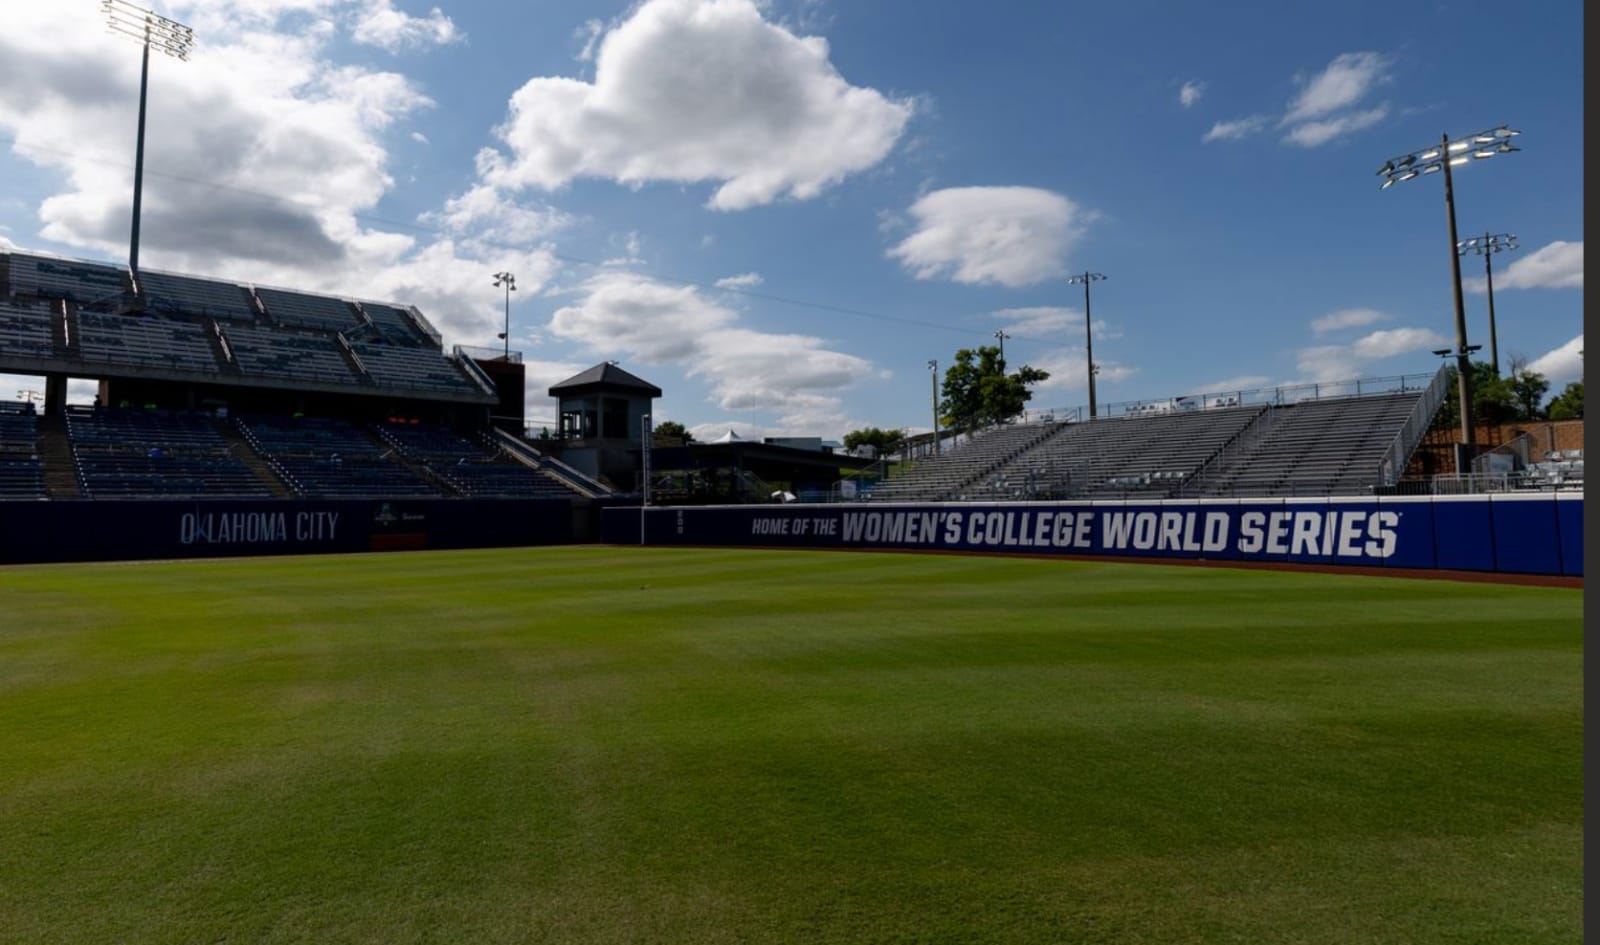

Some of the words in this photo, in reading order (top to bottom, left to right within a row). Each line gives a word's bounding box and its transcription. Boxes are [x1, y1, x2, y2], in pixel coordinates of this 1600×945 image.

[180, 506, 287, 544] OKLAHOMA
[296, 512, 340, 541] CITY
[752, 518, 788, 535] HOME
[792, 518, 810, 536] OF
[813, 518, 838, 536] THE
[842, 511, 963, 544] WOMEN'S
[966, 511, 1095, 548] COLLEGE
[1102, 511, 1230, 552] WORLD
[1237, 511, 1400, 558] SERIES
